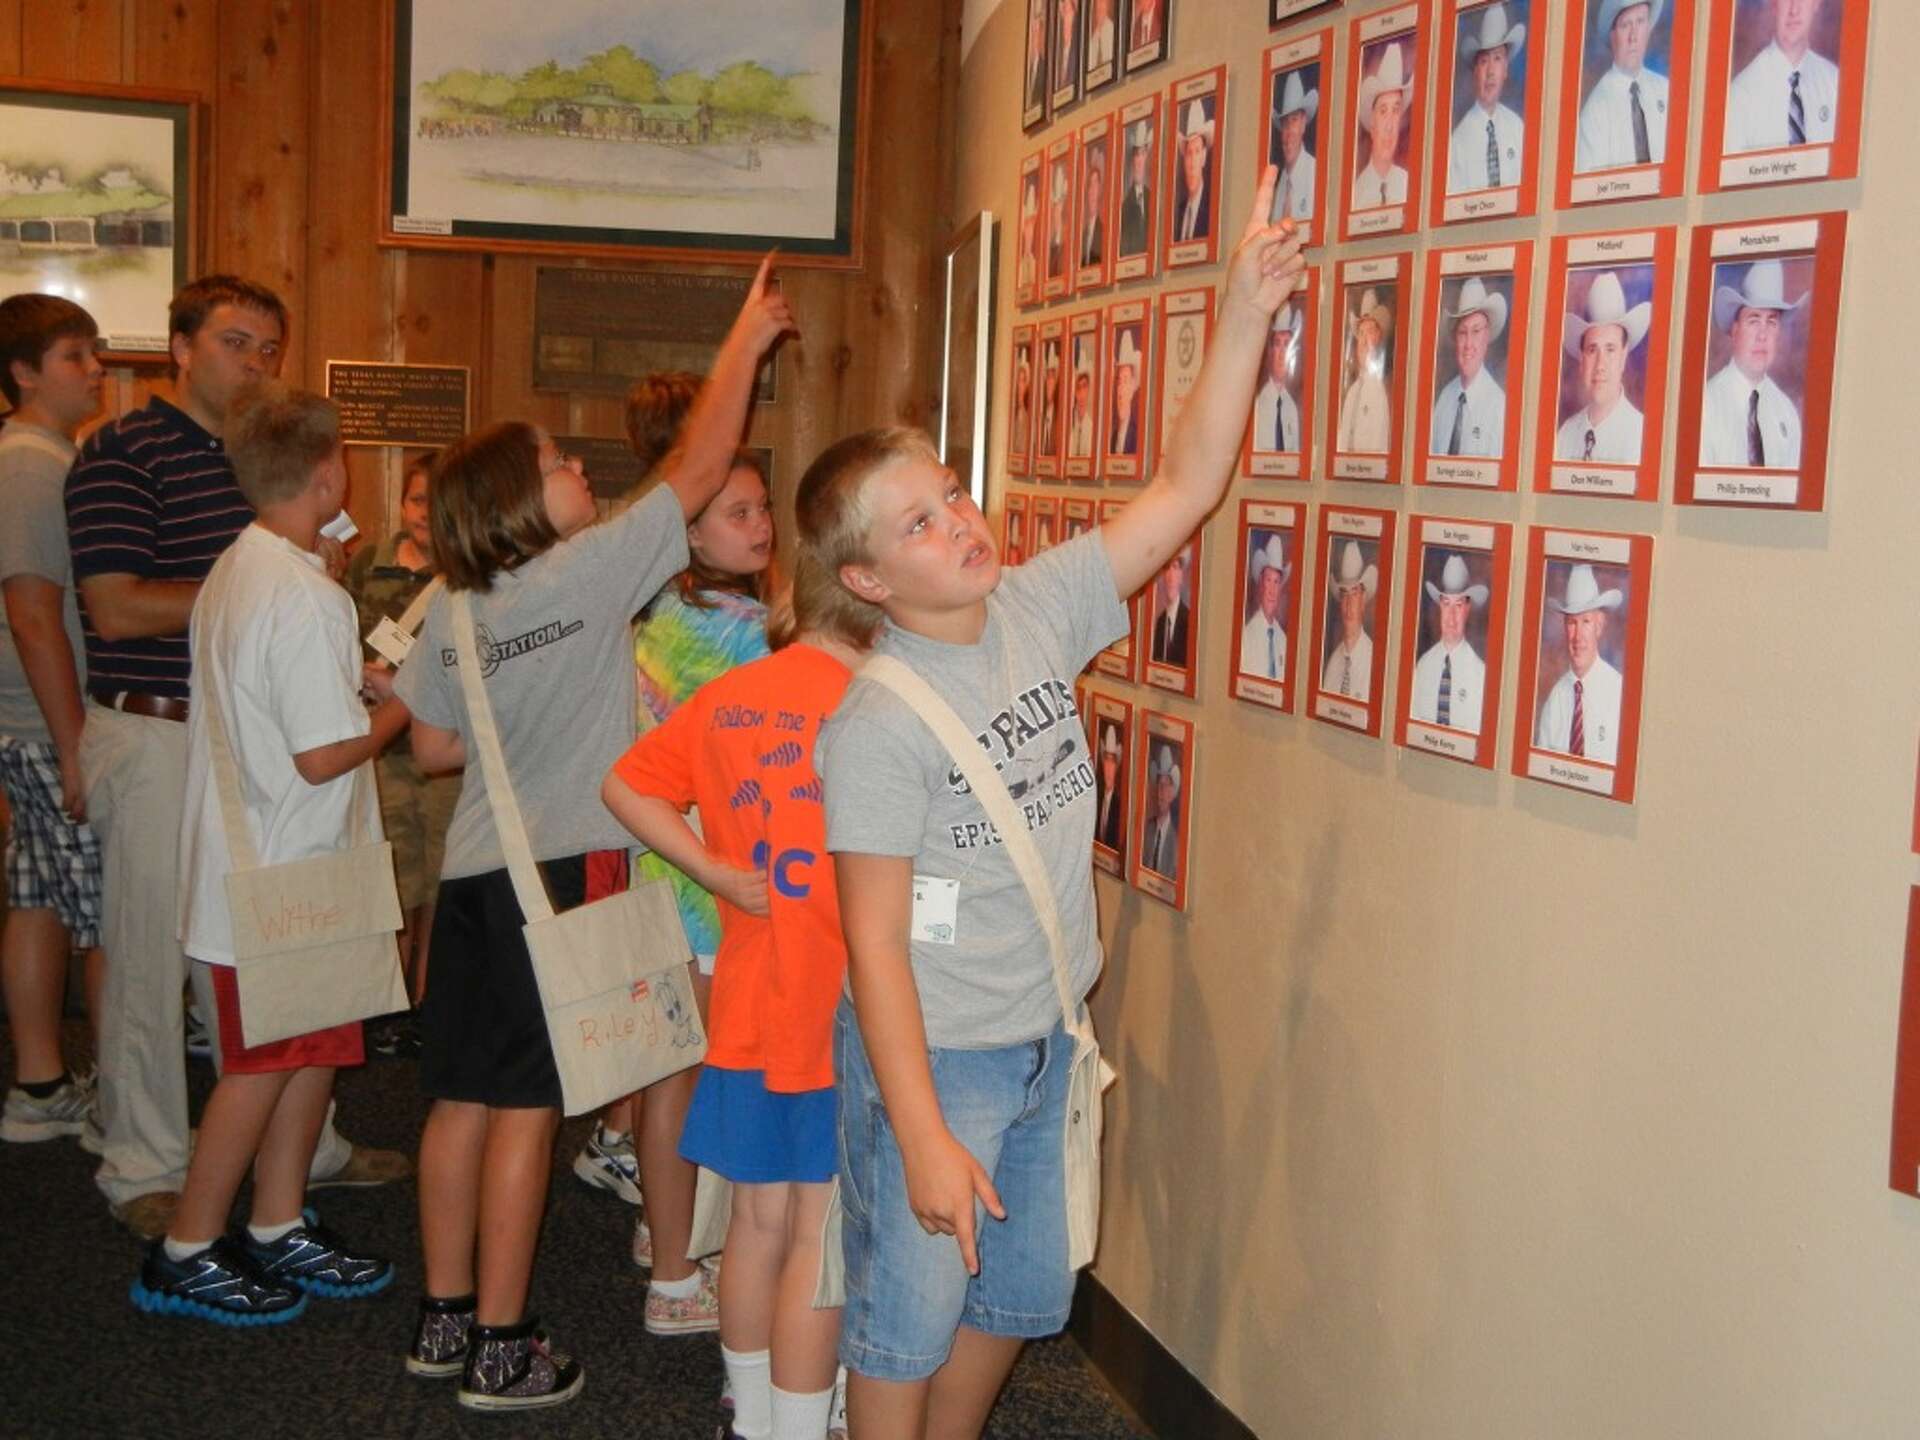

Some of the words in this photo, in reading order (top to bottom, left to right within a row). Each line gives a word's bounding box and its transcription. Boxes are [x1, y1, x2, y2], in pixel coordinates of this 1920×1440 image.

[1771, 161, 1797, 175] Wright
[1596, 240, 1625, 252] Midland
[1739, 235, 1781, 247] Monahans
[1570, 473, 1585, 486] Don
[1586, 473, 1614, 487] Williams
[1739, 484, 1771, 499] Breeding
[710, 704, 768, 731] Follow
[774, 709, 806, 732] me
